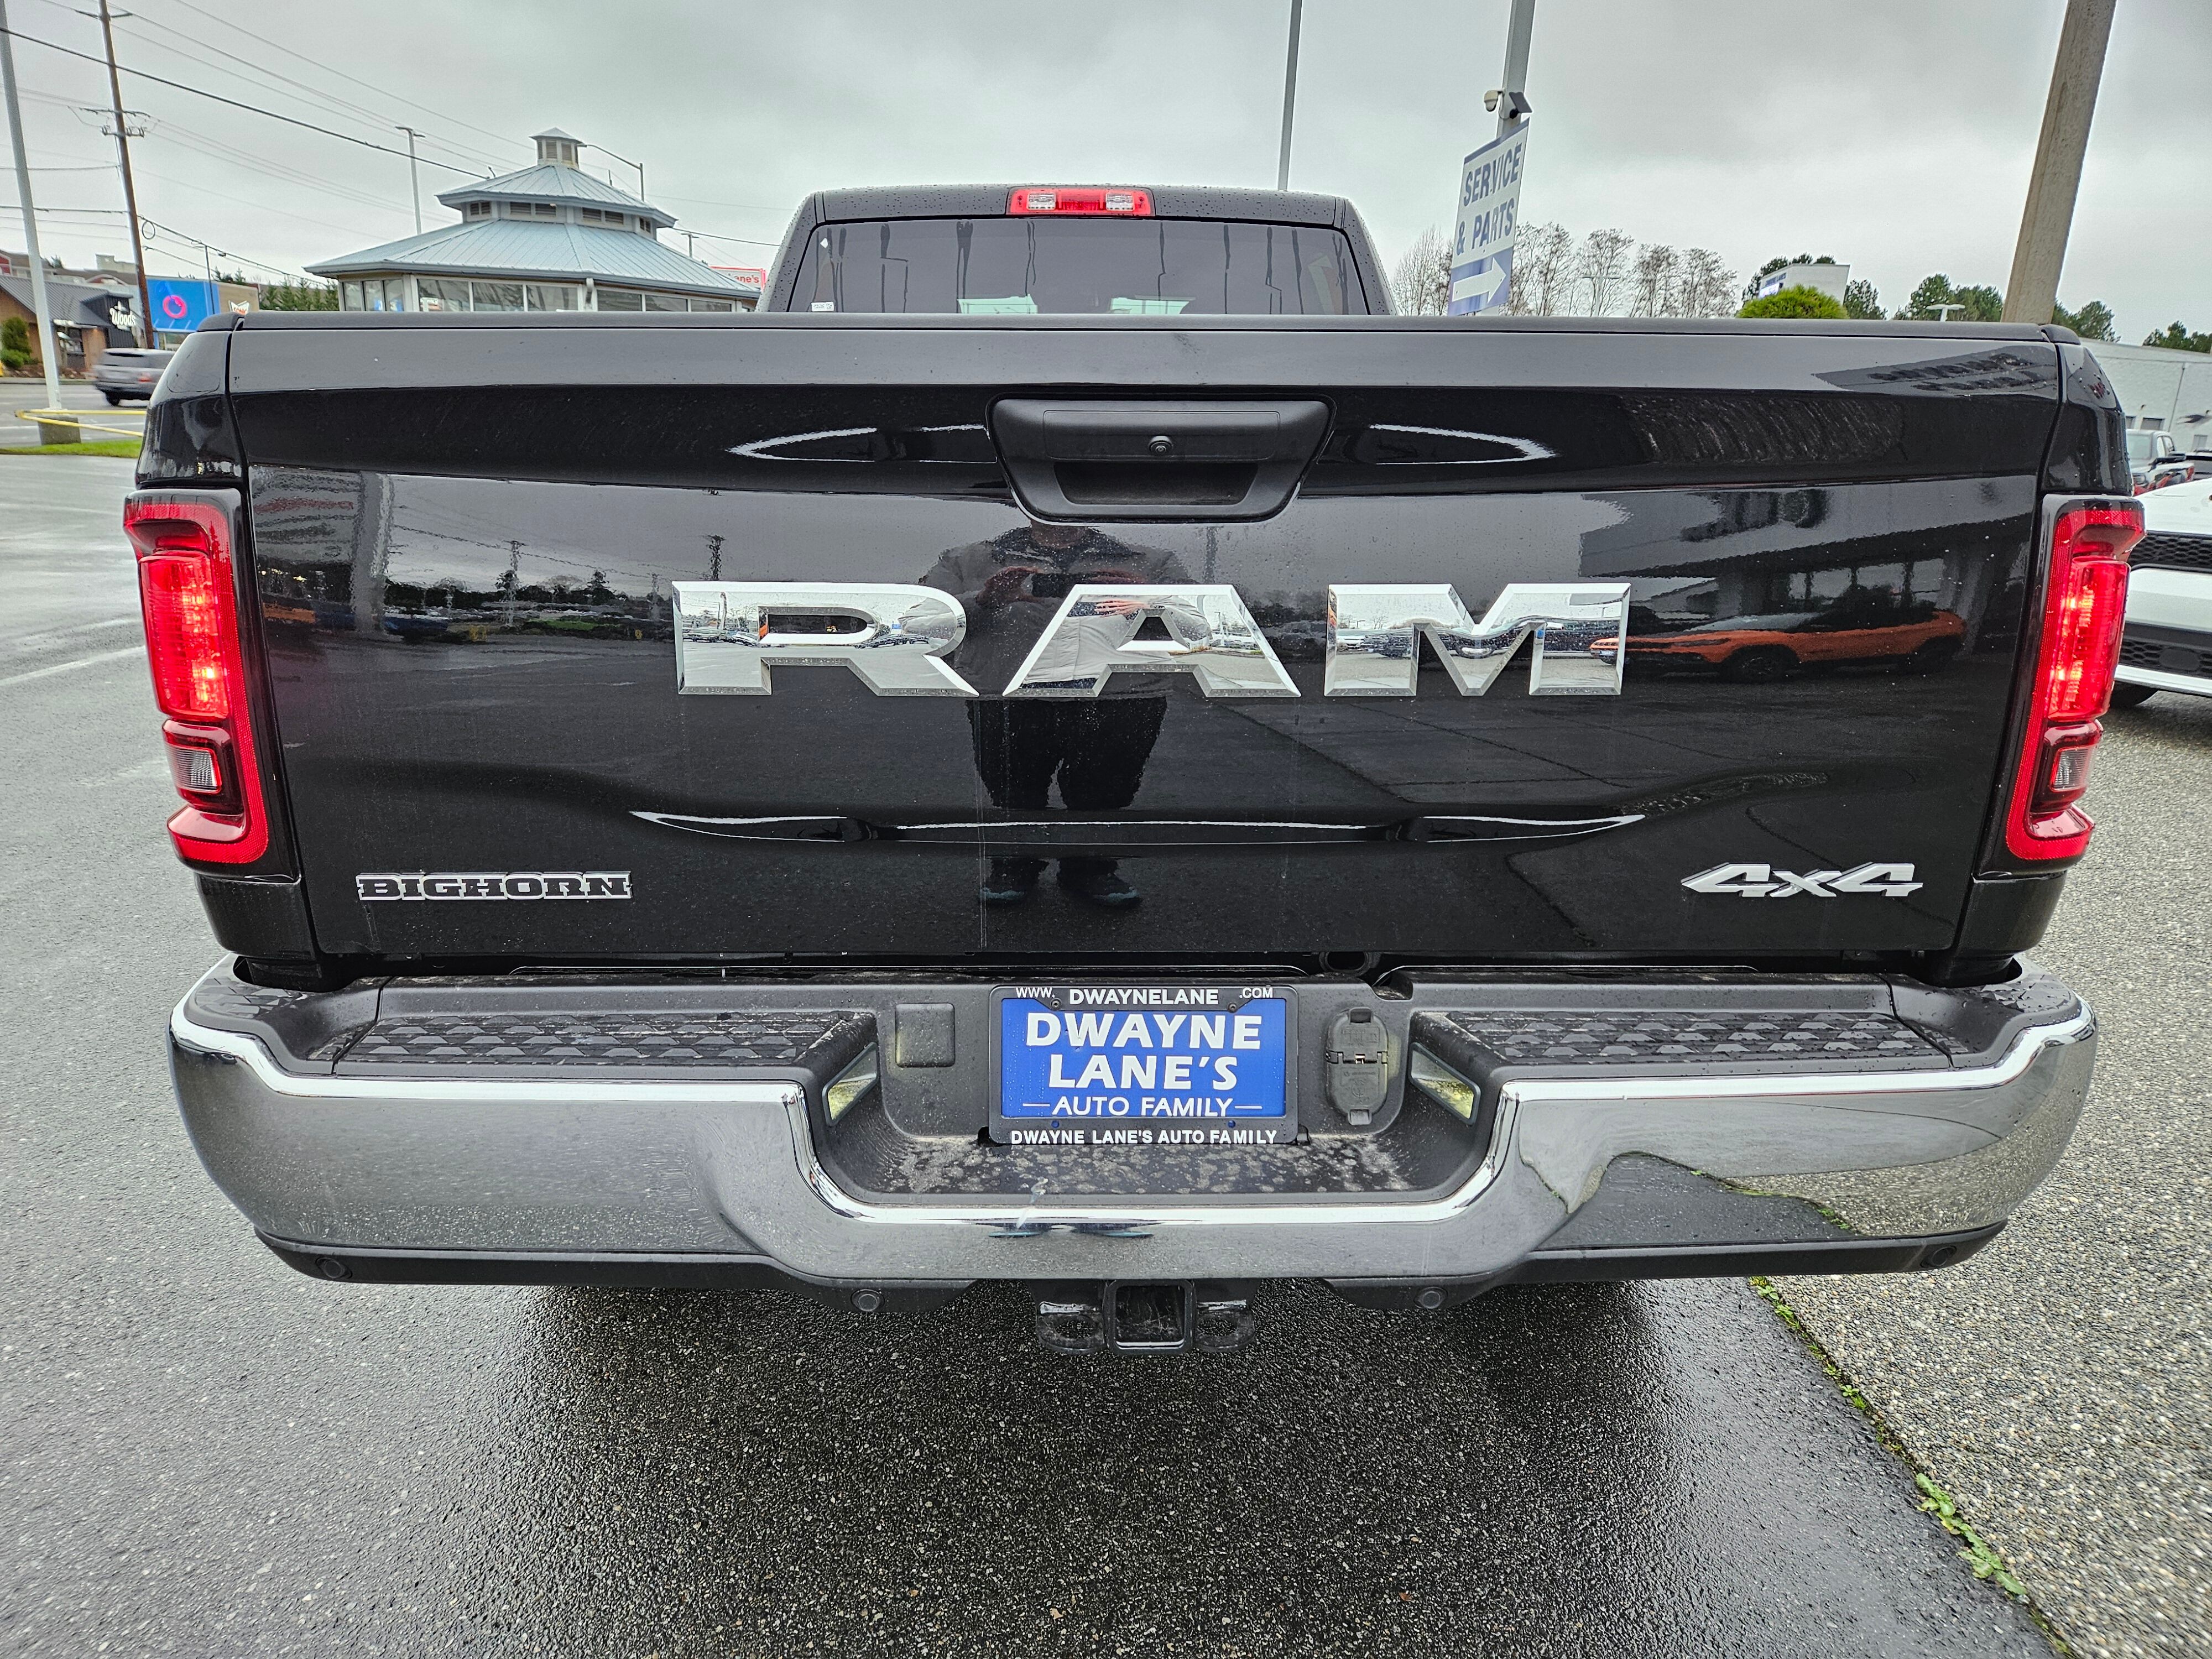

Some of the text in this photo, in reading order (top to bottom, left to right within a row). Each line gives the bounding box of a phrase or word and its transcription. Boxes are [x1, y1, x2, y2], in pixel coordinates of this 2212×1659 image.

[1464, 143, 1522, 207] SERVICE
[1456, 197, 1515, 255] & PARTS
[728, 273, 759, 284] ane's
[109, 307, 136, 326] Woods
[672, 581, 1631, 697] RAM
[356, 871, 633, 900] BIGHORN
[1681, 862, 1923, 897] 4x4
[1015, 987, 1273, 1005] WWW. DWAYNELANE .COM
[1026, 1013, 1262, 1049] DWAYNE
[1048, 1054, 1238, 1091] LANE'S
[1052, 1096, 1233, 1117] AUTO FAMILY
[1011, 1130, 1277, 1145] DWAYNE LANE'S AUTO FAMILY
